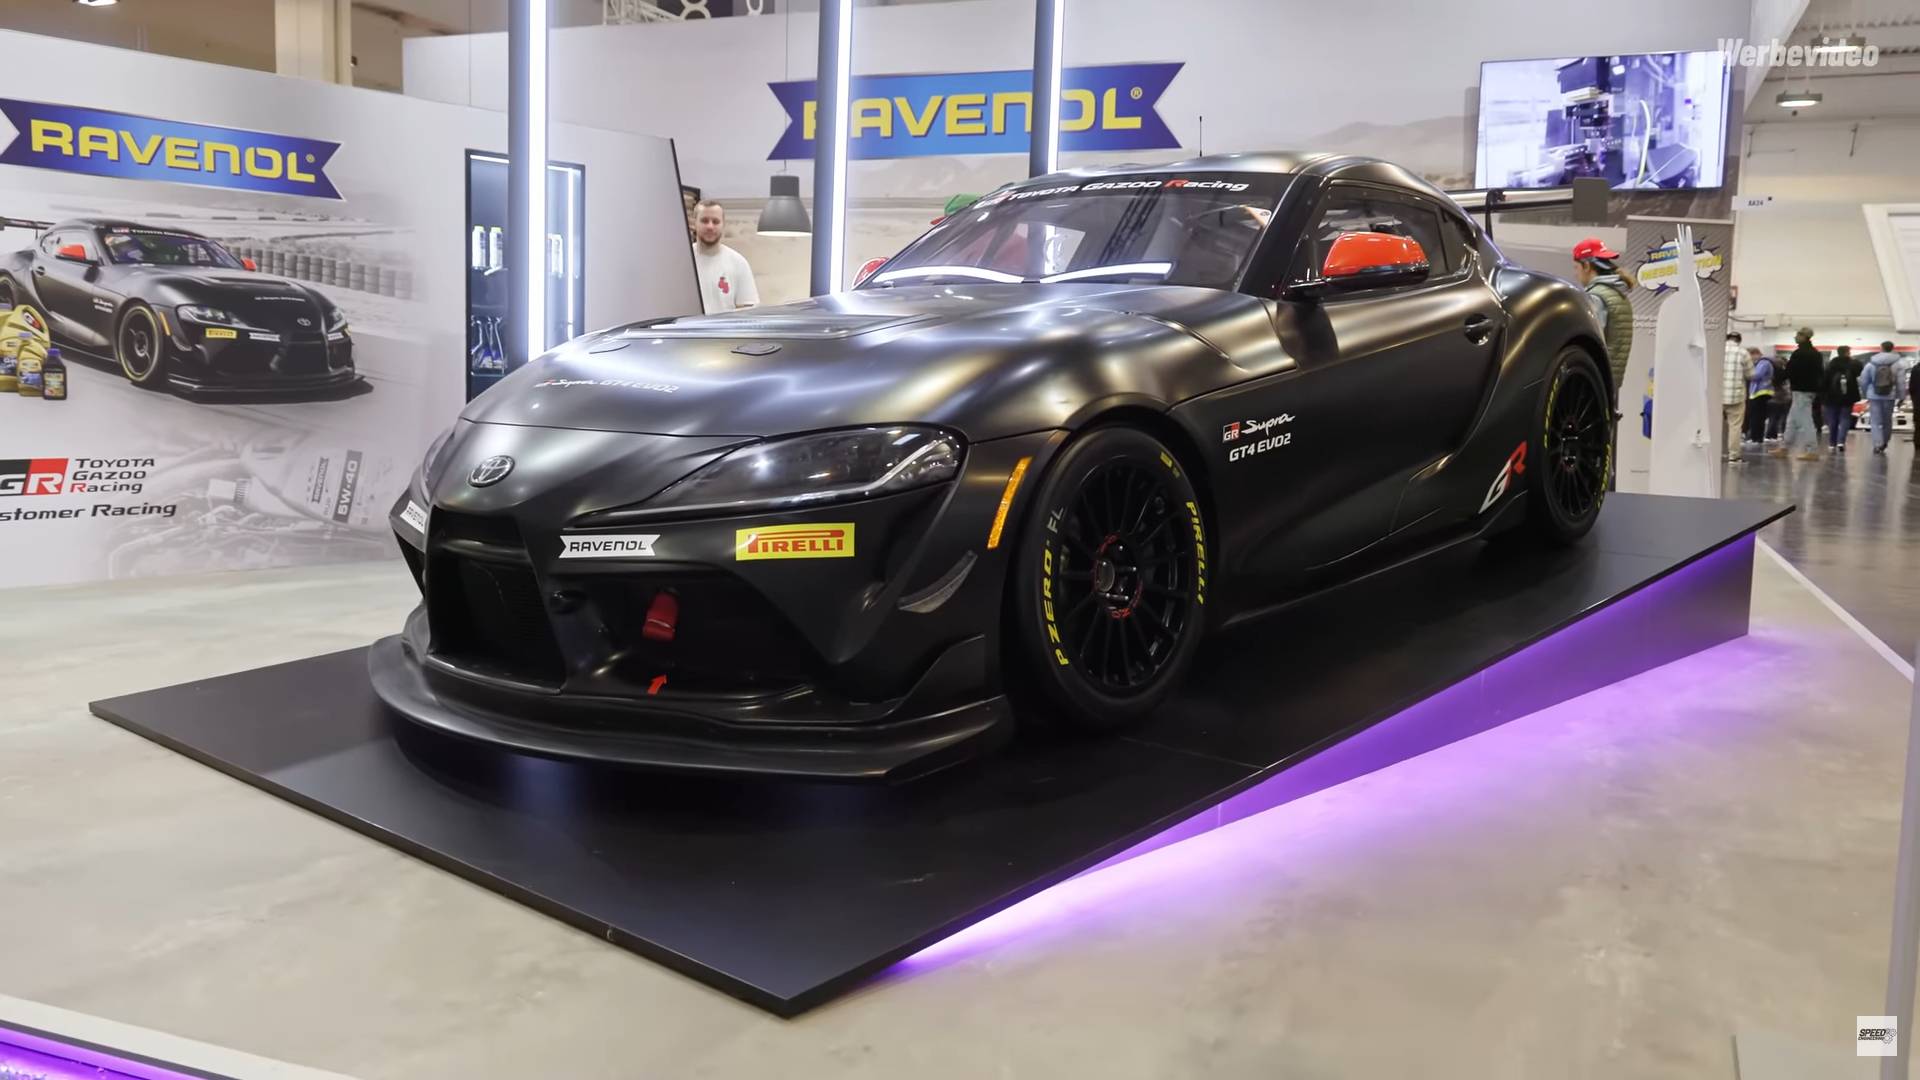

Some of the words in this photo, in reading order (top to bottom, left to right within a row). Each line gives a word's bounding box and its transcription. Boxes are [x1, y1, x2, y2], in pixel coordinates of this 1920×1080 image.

[1008, 185, 1080, 200] TOYOTA
[1082, 180, 1163, 191] GAZOO
[1163, 179, 1250, 192] Racing
[1241, 413, 1296, 436] Supra
[1229, 443, 1256, 462] GT4
[1257, 432, 1292, 454] EVO2
[75, 457, 155, 469] TOYOTA
[72, 470, 147, 481] GAZOO
[70, 481, 143, 495] Racing
[91, 502, 177, 518] Racing
[569, 540, 648, 553] RAVENOL
[747, 529, 845, 554] PIRELLI
[1185, 501, 1206, 606] PIRELLI
